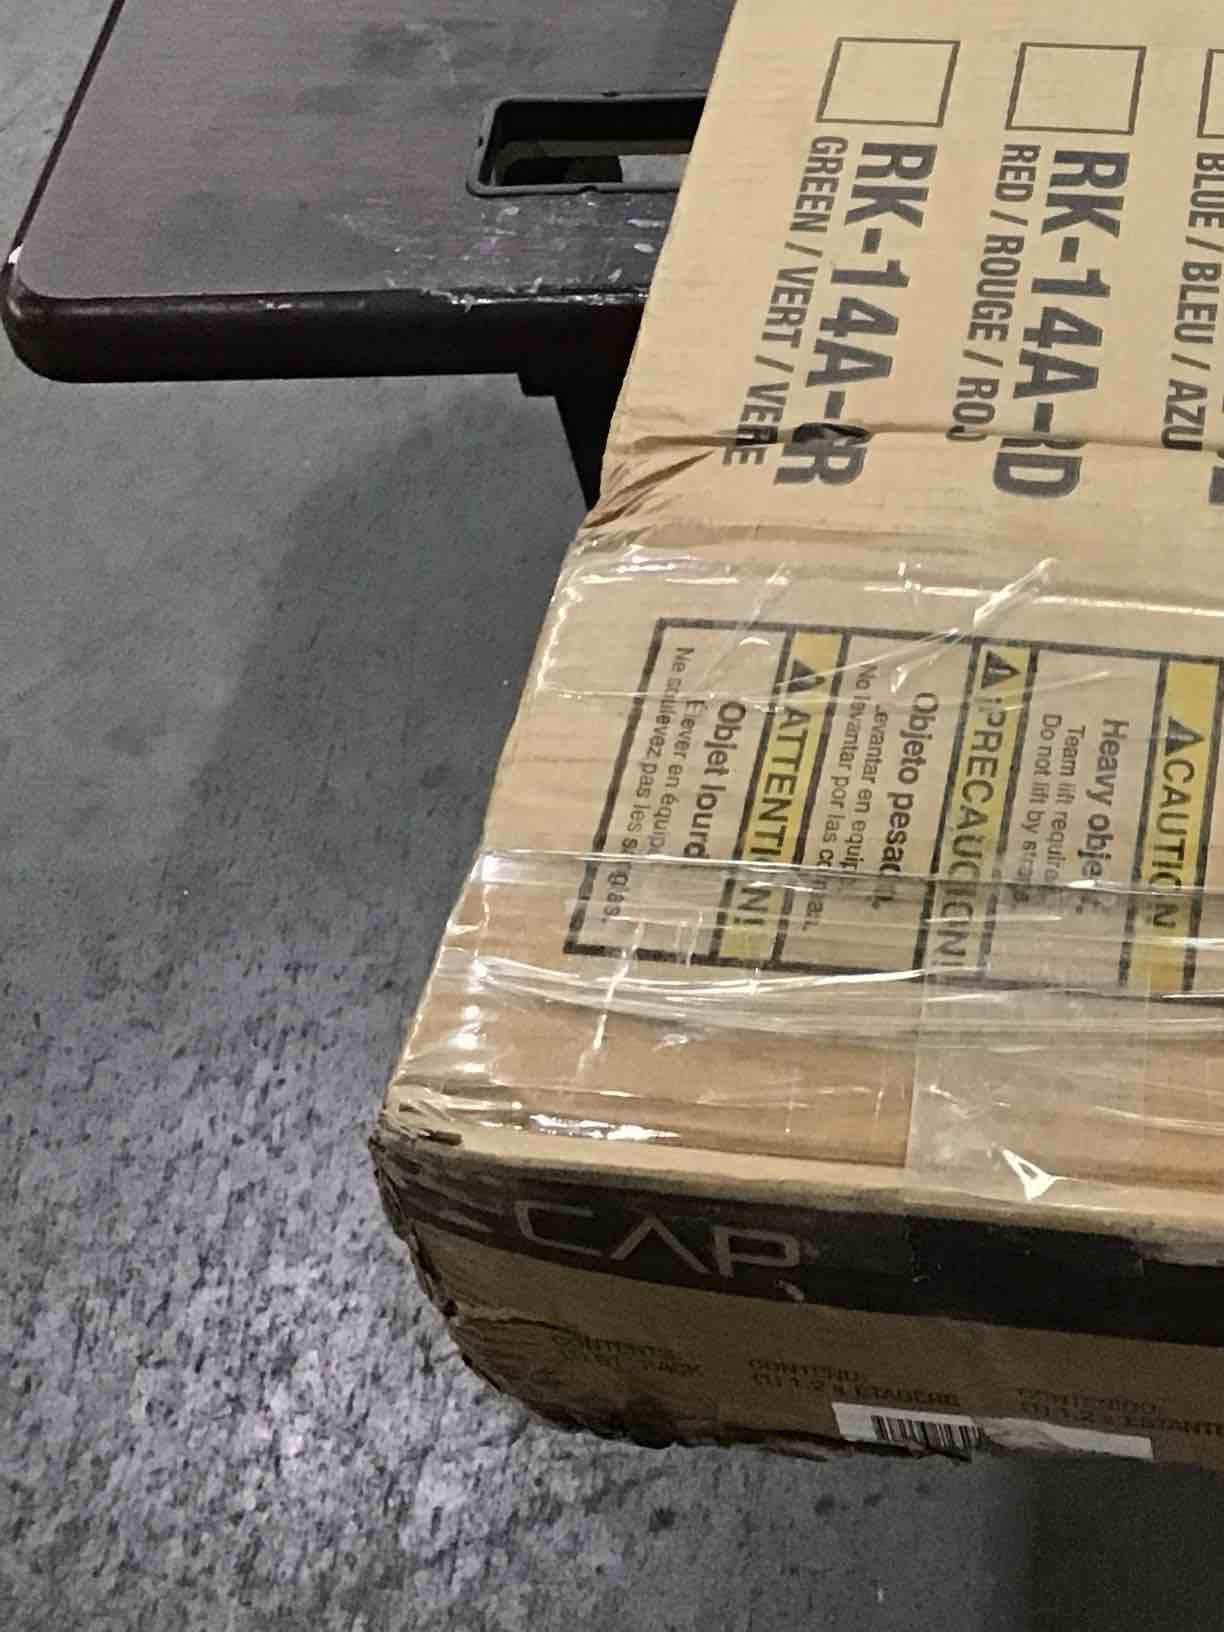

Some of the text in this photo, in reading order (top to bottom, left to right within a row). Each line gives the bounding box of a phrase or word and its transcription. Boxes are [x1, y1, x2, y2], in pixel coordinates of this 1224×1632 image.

[788, 135, 850, 233] GREEN
[993, 143, 1042, 203] RED
[760, 265, 819, 349] VERT
[966, 233, 1026, 344] ROUGE
[1172, 260, 1223, 345] BLEU
[671, 646, 696, 673] Ne
[855, 663, 879, 690] No
[702, 700, 748, 777] Objet
[836, 693, 874, 772] levantar
[896, 691, 940, 786] Objeto
[1040, 713, 1064, 740] Do
[1034, 744, 1054, 777] not
[1058, 724, 1087, 778] Team
[1086, 718, 1131, 807] Heavy
[634, 760, 660, 801] pas
[828, 775, 850, 811] por
[1029, 780, 1052, 805] lift
[1054, 780, 1079, 805] lift
[626, 802, 652, 834] les
[852, 790, 873, 814] en
[1021, 808, 1046, 836] by
[820, 815, 842, 845] las
[1143, 757, 1196, 930] CAUTION
